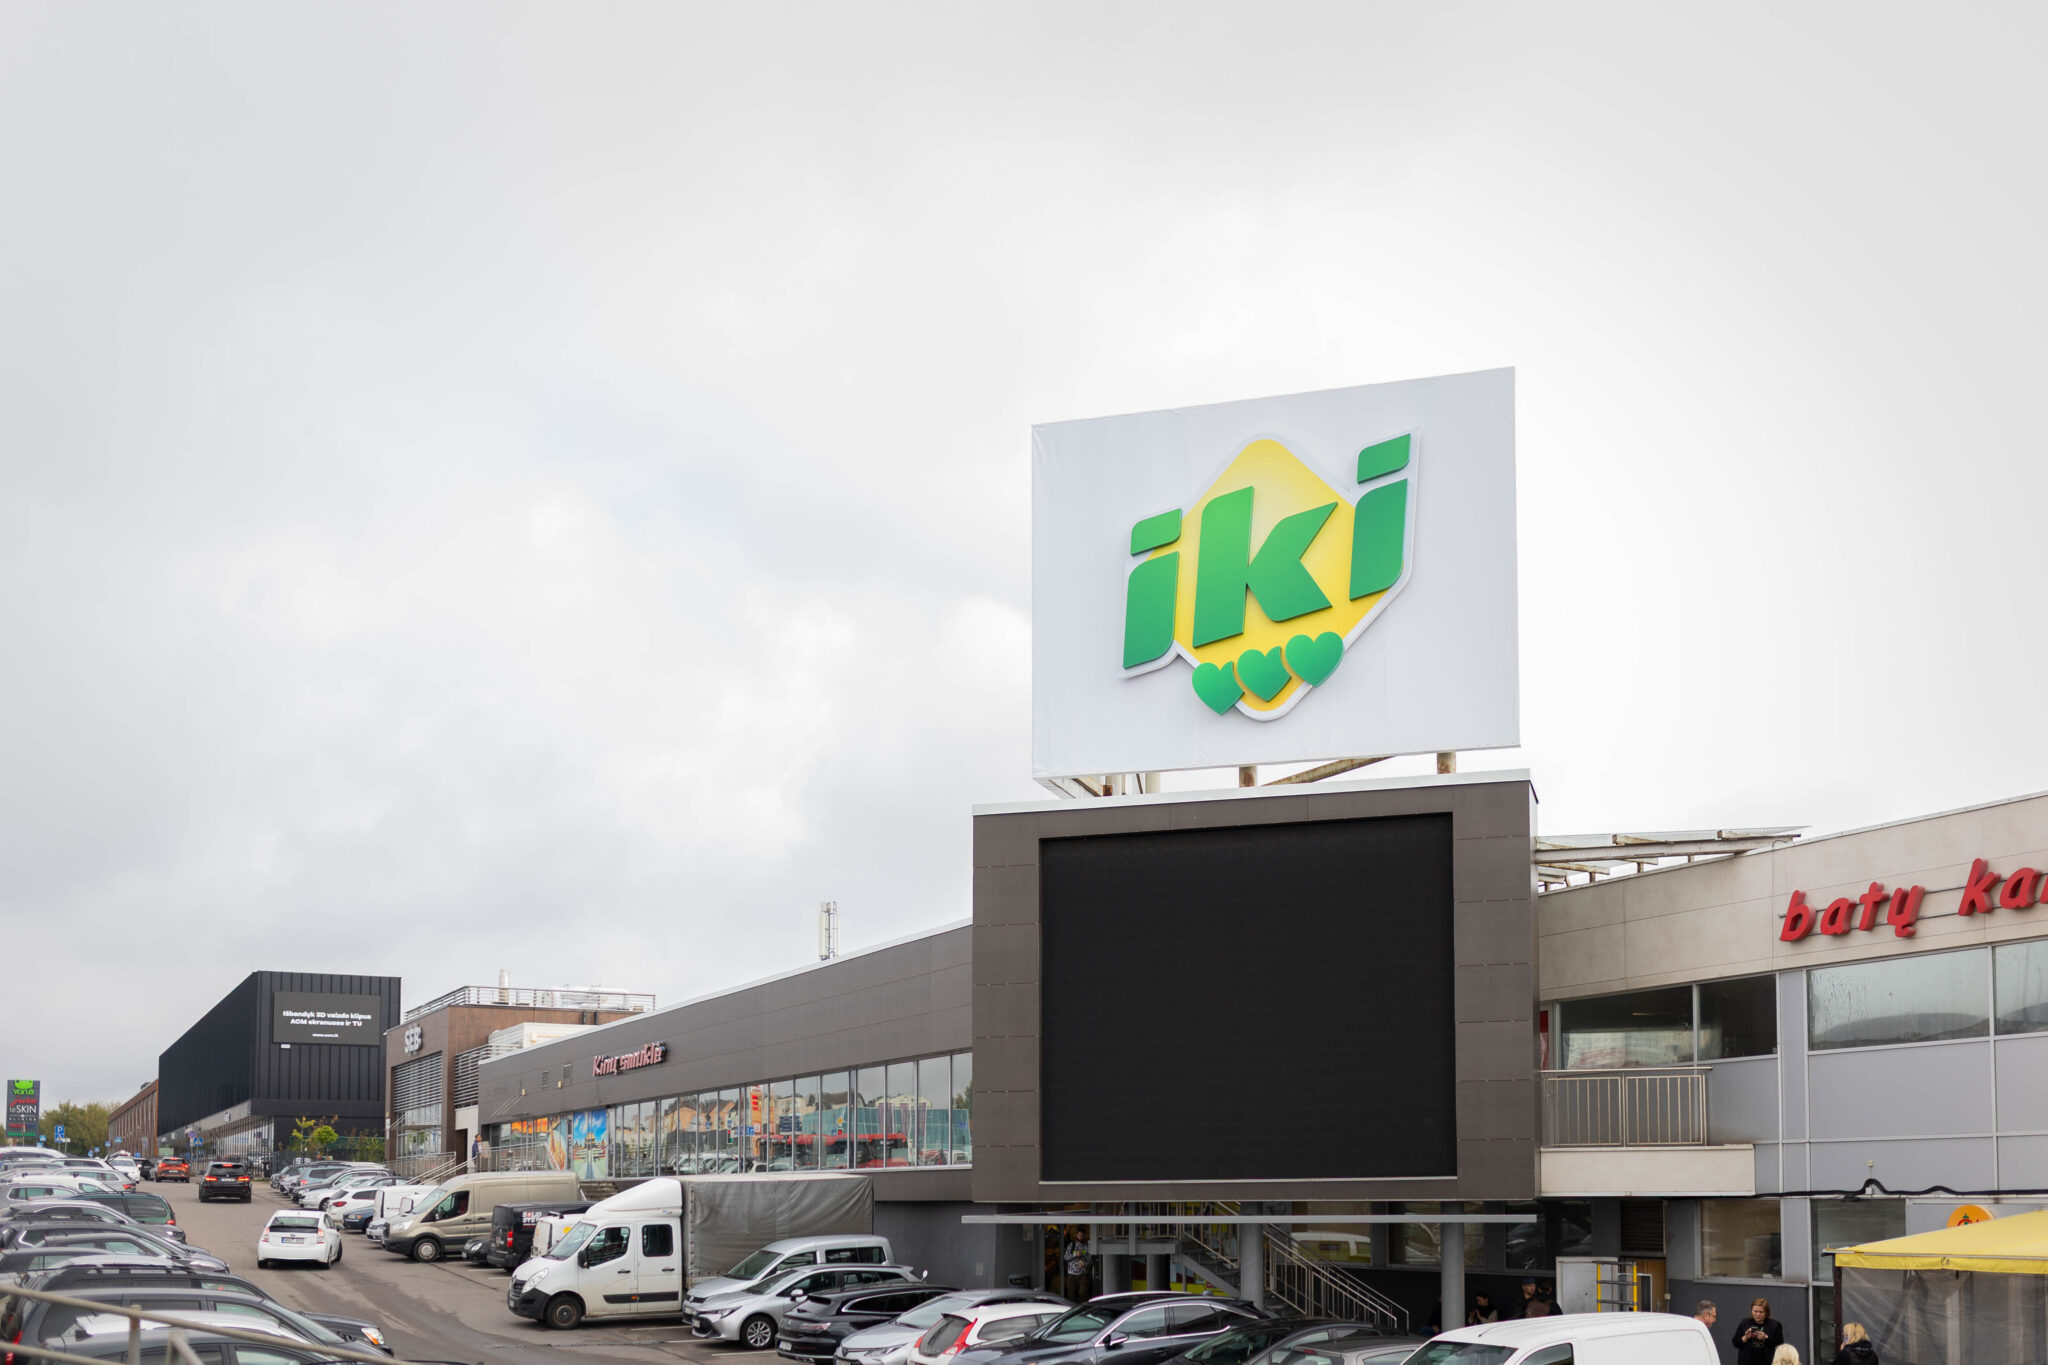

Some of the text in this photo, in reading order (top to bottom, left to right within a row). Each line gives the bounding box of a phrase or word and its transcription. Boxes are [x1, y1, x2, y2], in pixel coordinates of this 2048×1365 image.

[1122, 432, 1411, 670] iki
[1780, 857, 2048, 940] batų ka
